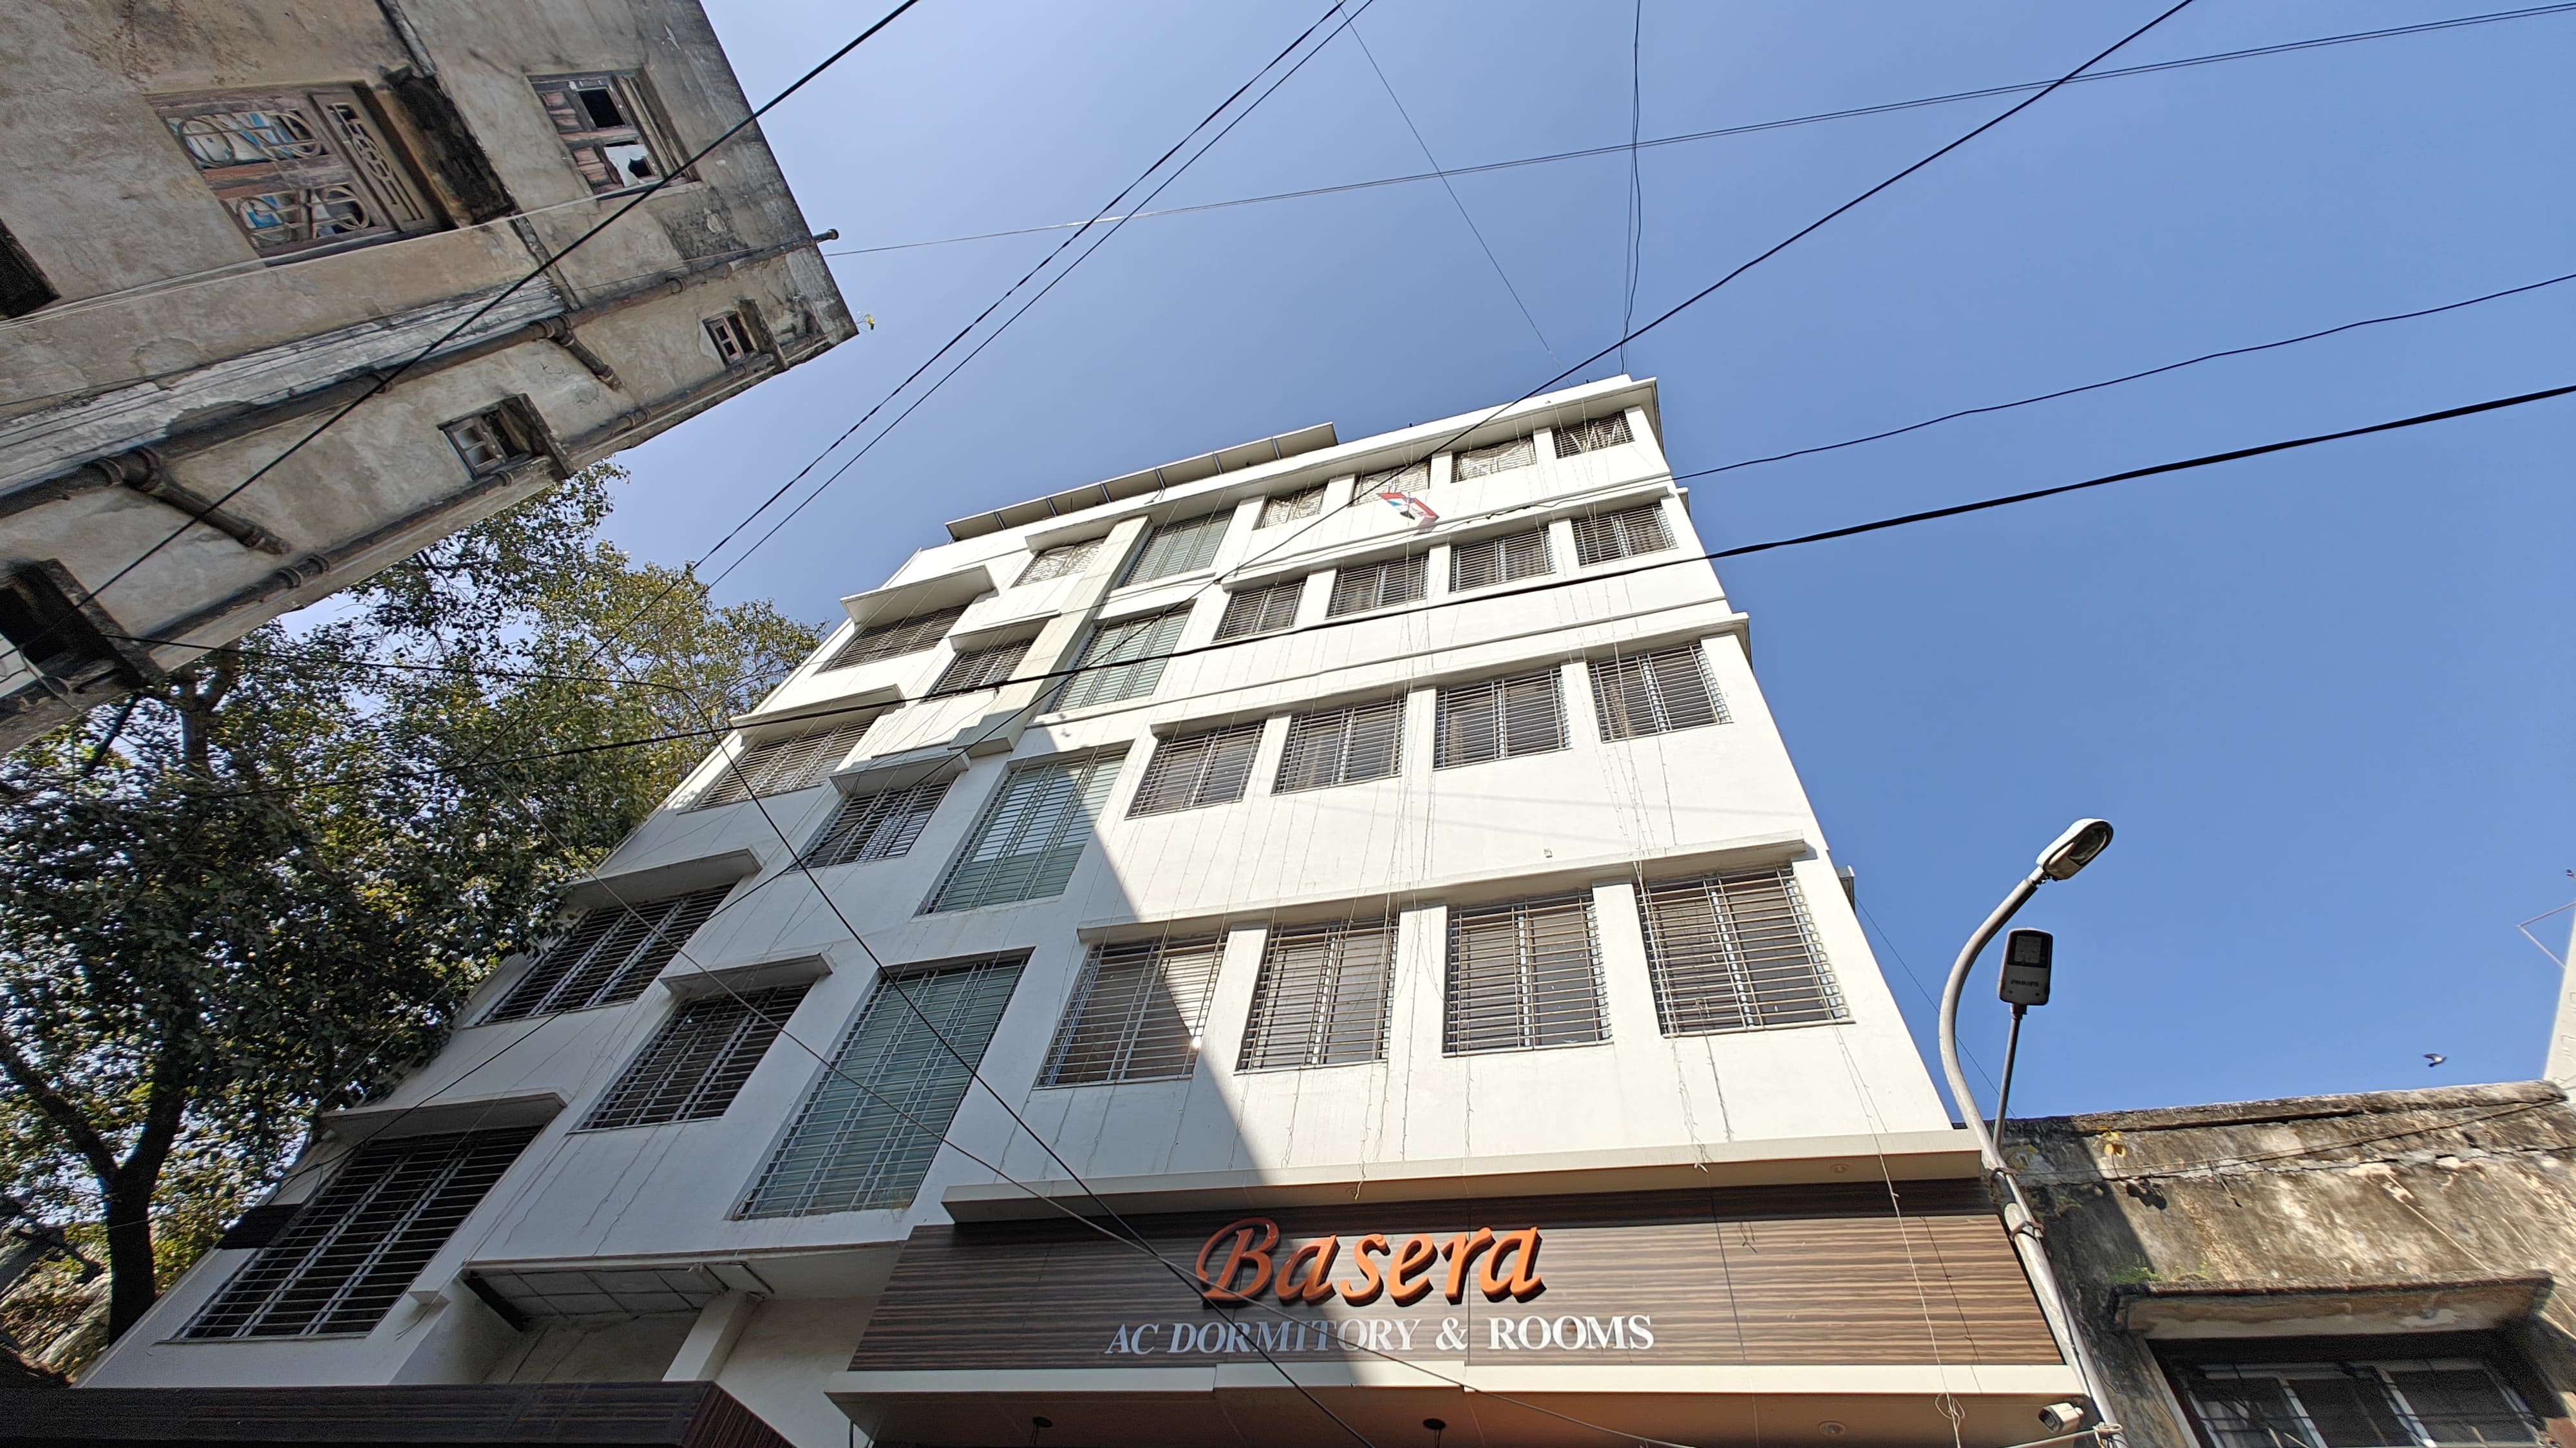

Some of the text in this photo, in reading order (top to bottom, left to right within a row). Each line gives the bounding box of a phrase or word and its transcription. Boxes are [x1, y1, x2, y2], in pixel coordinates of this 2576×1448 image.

[1195, 1217, 1546, 1306] Basera
[1105, 1315, 1654, 1355] AC DORMITORY & ROOMS
